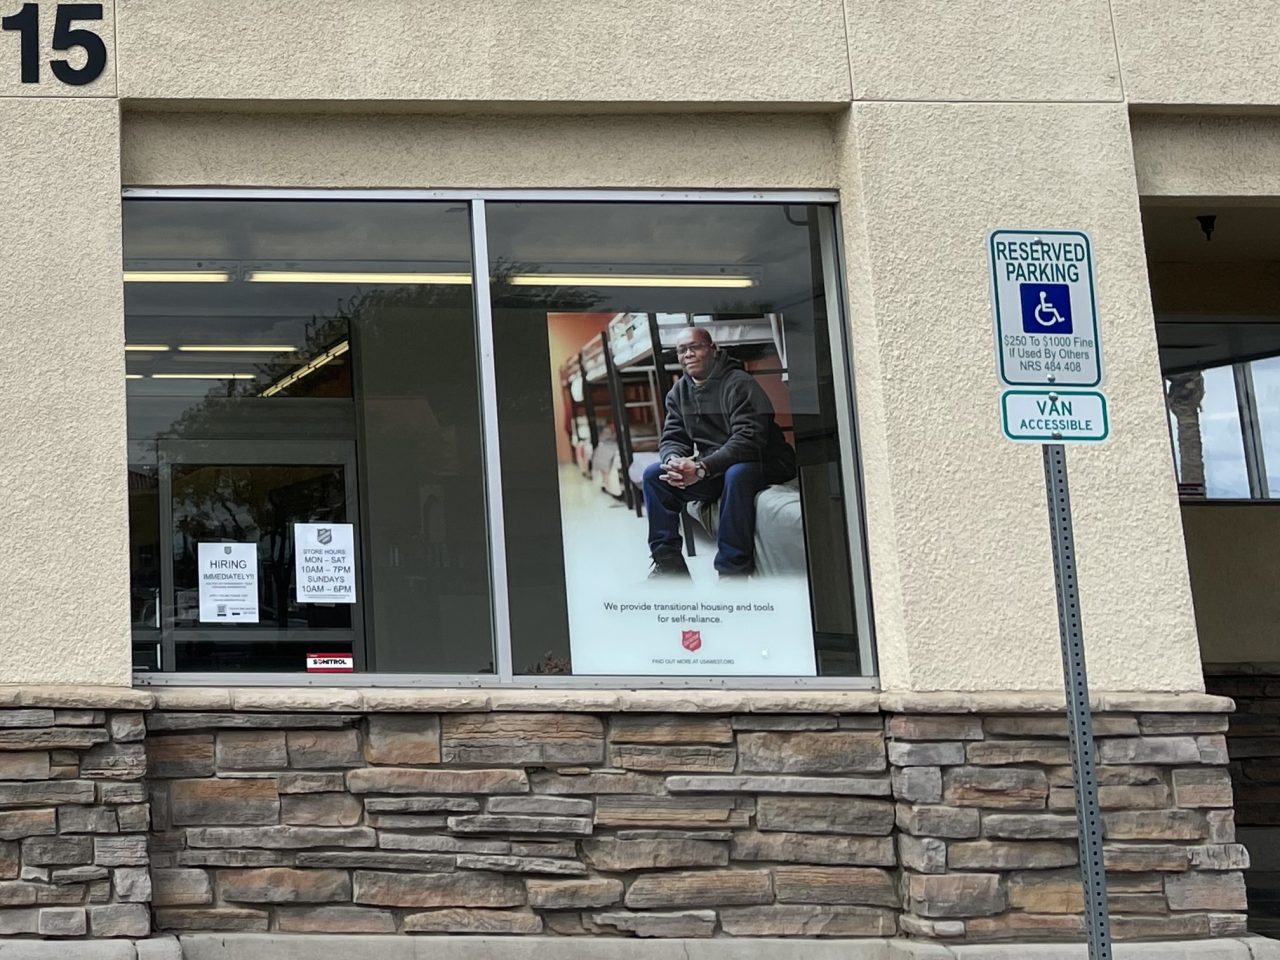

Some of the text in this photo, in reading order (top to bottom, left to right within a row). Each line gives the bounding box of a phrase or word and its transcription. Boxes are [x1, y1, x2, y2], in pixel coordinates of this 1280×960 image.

[996, 241, 1085, 262] RESERVED
[1006, 262, 1080, 283] PARKING
[1004, 334, 1094, 348] $250 To $1000 Fine
[1009, 347, 1090, 361] If Used By Others
[1020, 361, 1081, 372] NRS 484.408
[1036, 400, 1073, 417] VAN
[1020, 419, 1093, 431] ACCESSIBLE
[210, 560, 247, 569] HIRING
[307, 575, 345, 583] SUNDAYS
[302, 585, 324, 593] 10AM
[333, 585, 352, 593] 6PM
[604, 602, 774, 613] We provide transitional housing and tools
[657, 614, 723, 623] for self-reliance.
